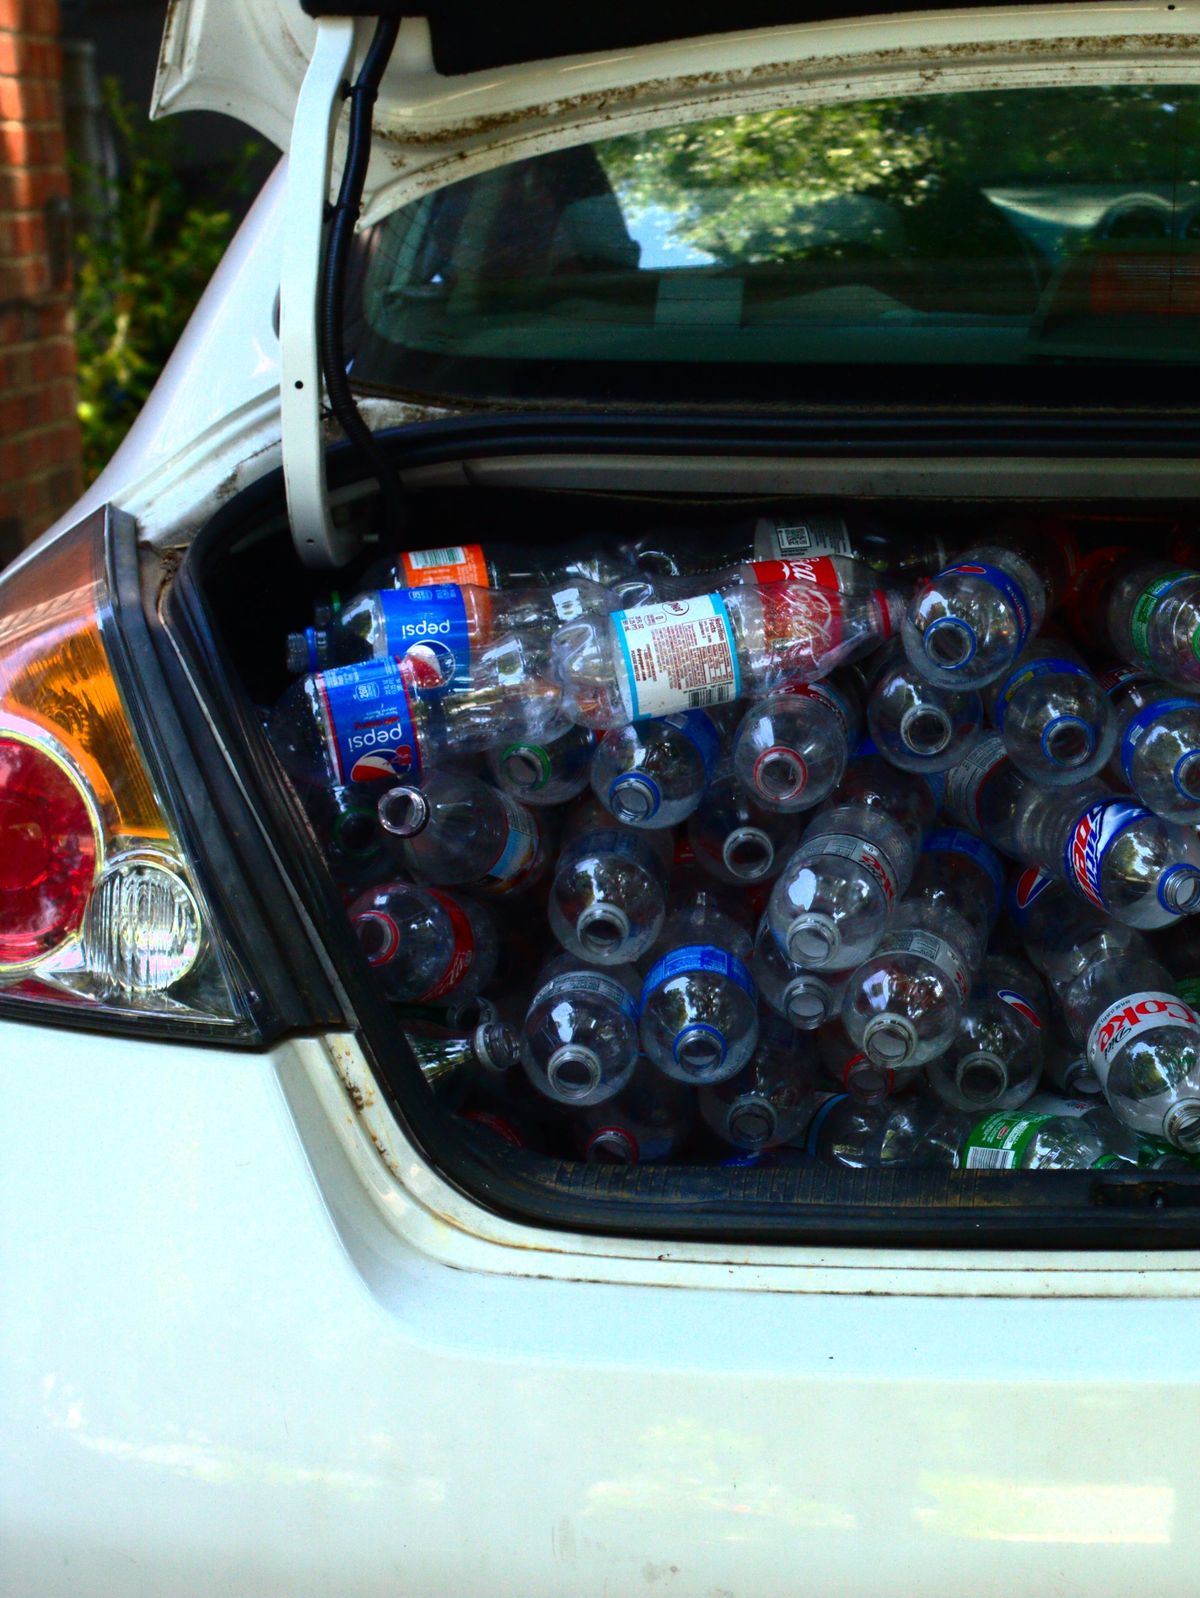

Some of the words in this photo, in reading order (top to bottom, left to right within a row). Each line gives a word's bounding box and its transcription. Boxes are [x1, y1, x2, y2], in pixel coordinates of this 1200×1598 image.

[402, 620, 450, 639] pepsi
[348, 723, 402, 752] pepsi
[1098, 1000, 1196, 1052] Coke
